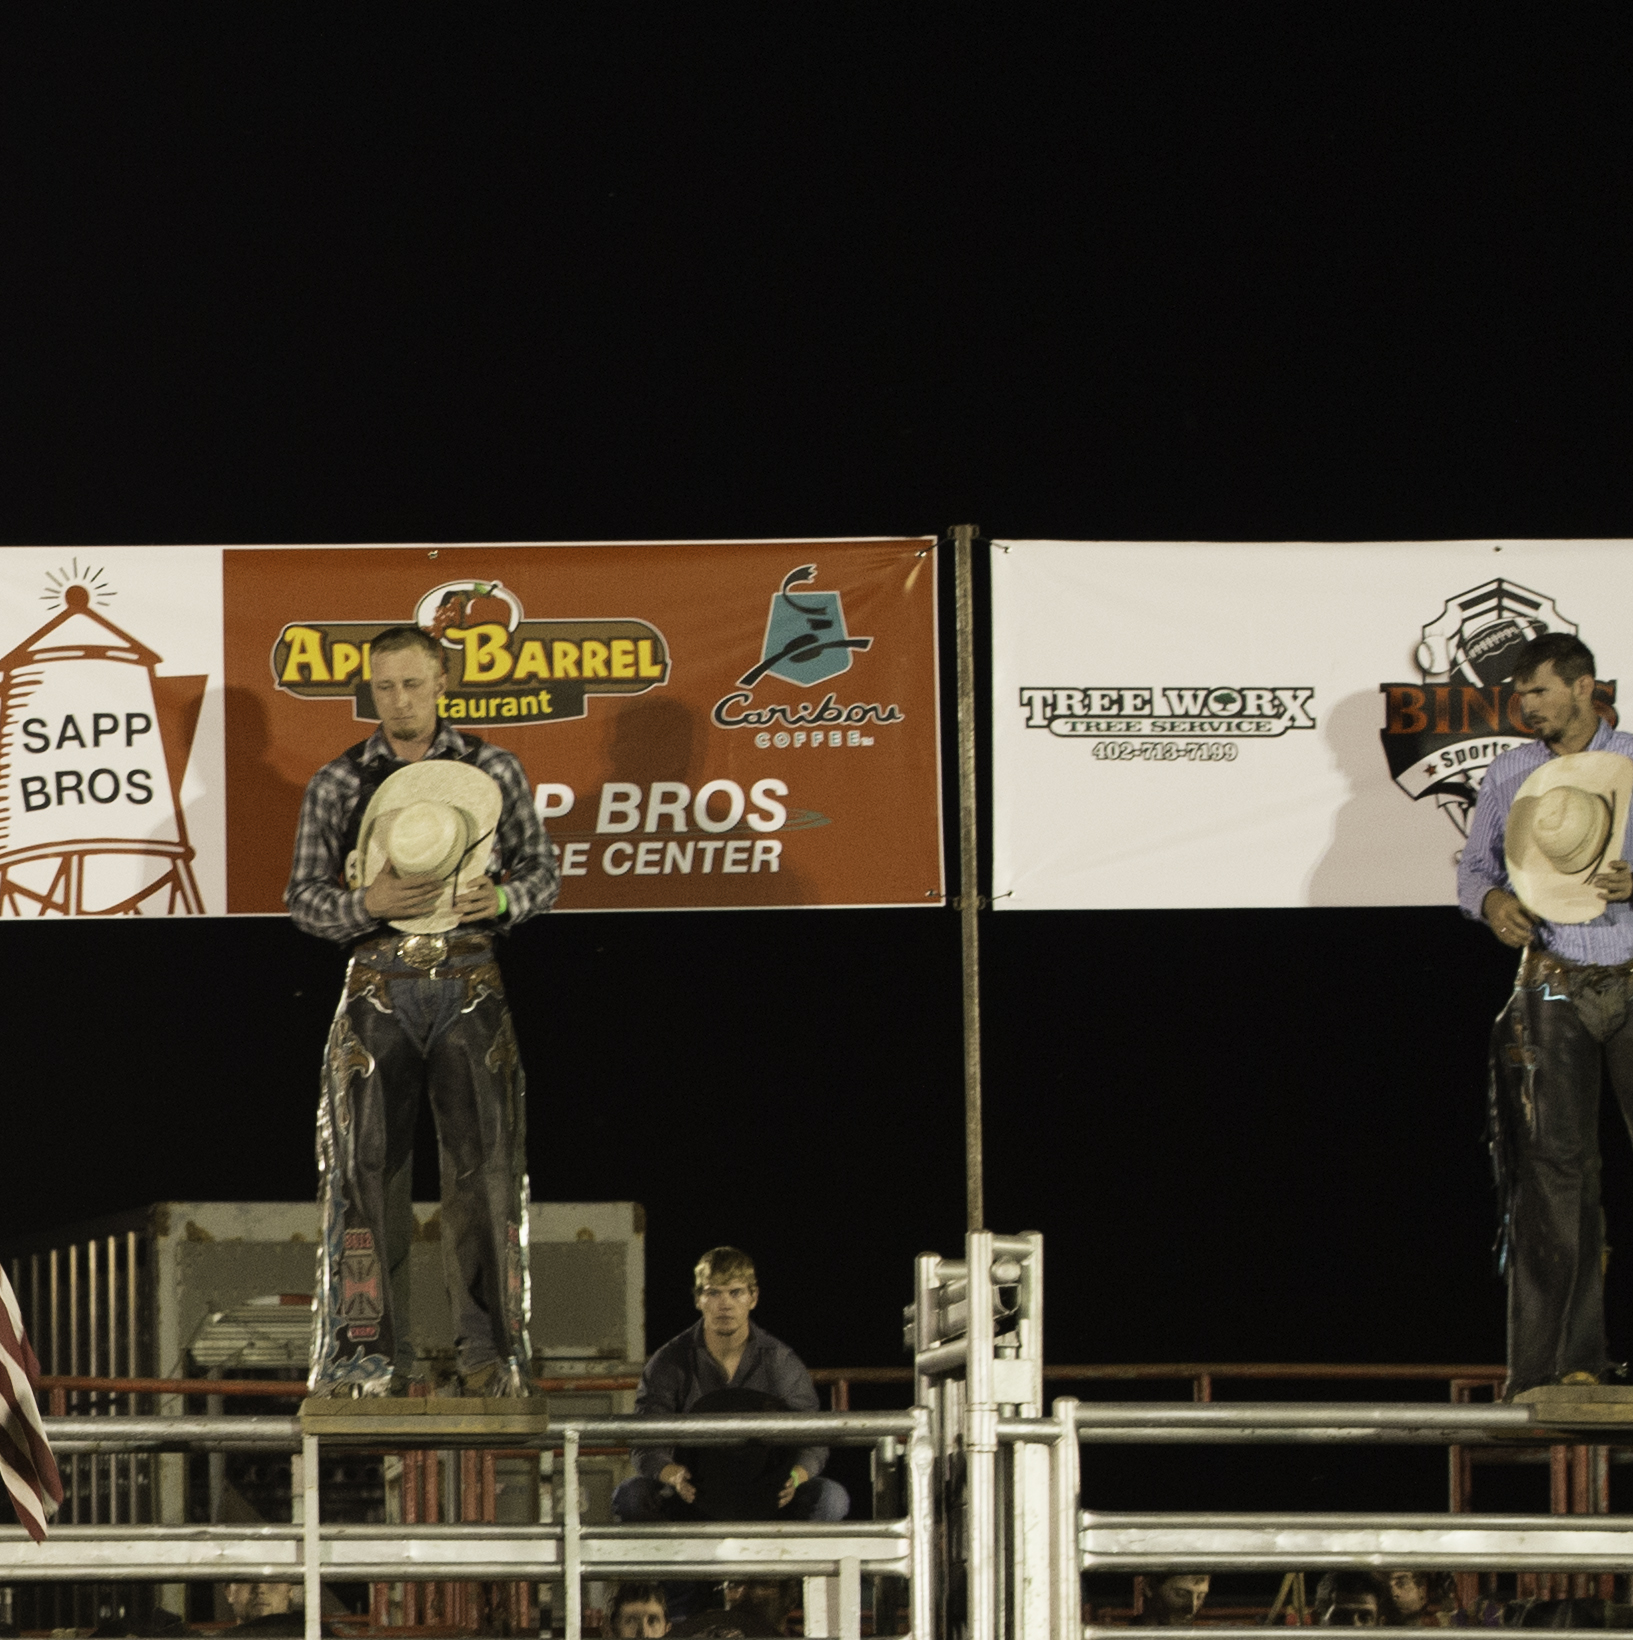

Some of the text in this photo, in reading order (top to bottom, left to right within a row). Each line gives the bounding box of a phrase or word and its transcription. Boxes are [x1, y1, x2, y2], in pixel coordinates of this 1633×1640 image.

[445, 622, 665, 683] BARREL
[435, 690, 554, 719] taurant
[710, 691, 905, 729] Caribou
[1019, 687, 1316, 730] TREE WORX
[21, 711, 154, 754] SAPP
[753, 730, 861, 749] COFFEE
[1064, 720, 1273, 733] TREE SERVICE
[1091, 741, 1239, 762] 402-713-7199
[20, 767, 155, 813] BROS
[595, 778, 790, 834] BROS
[601, 839, 783, 876] CENTER
